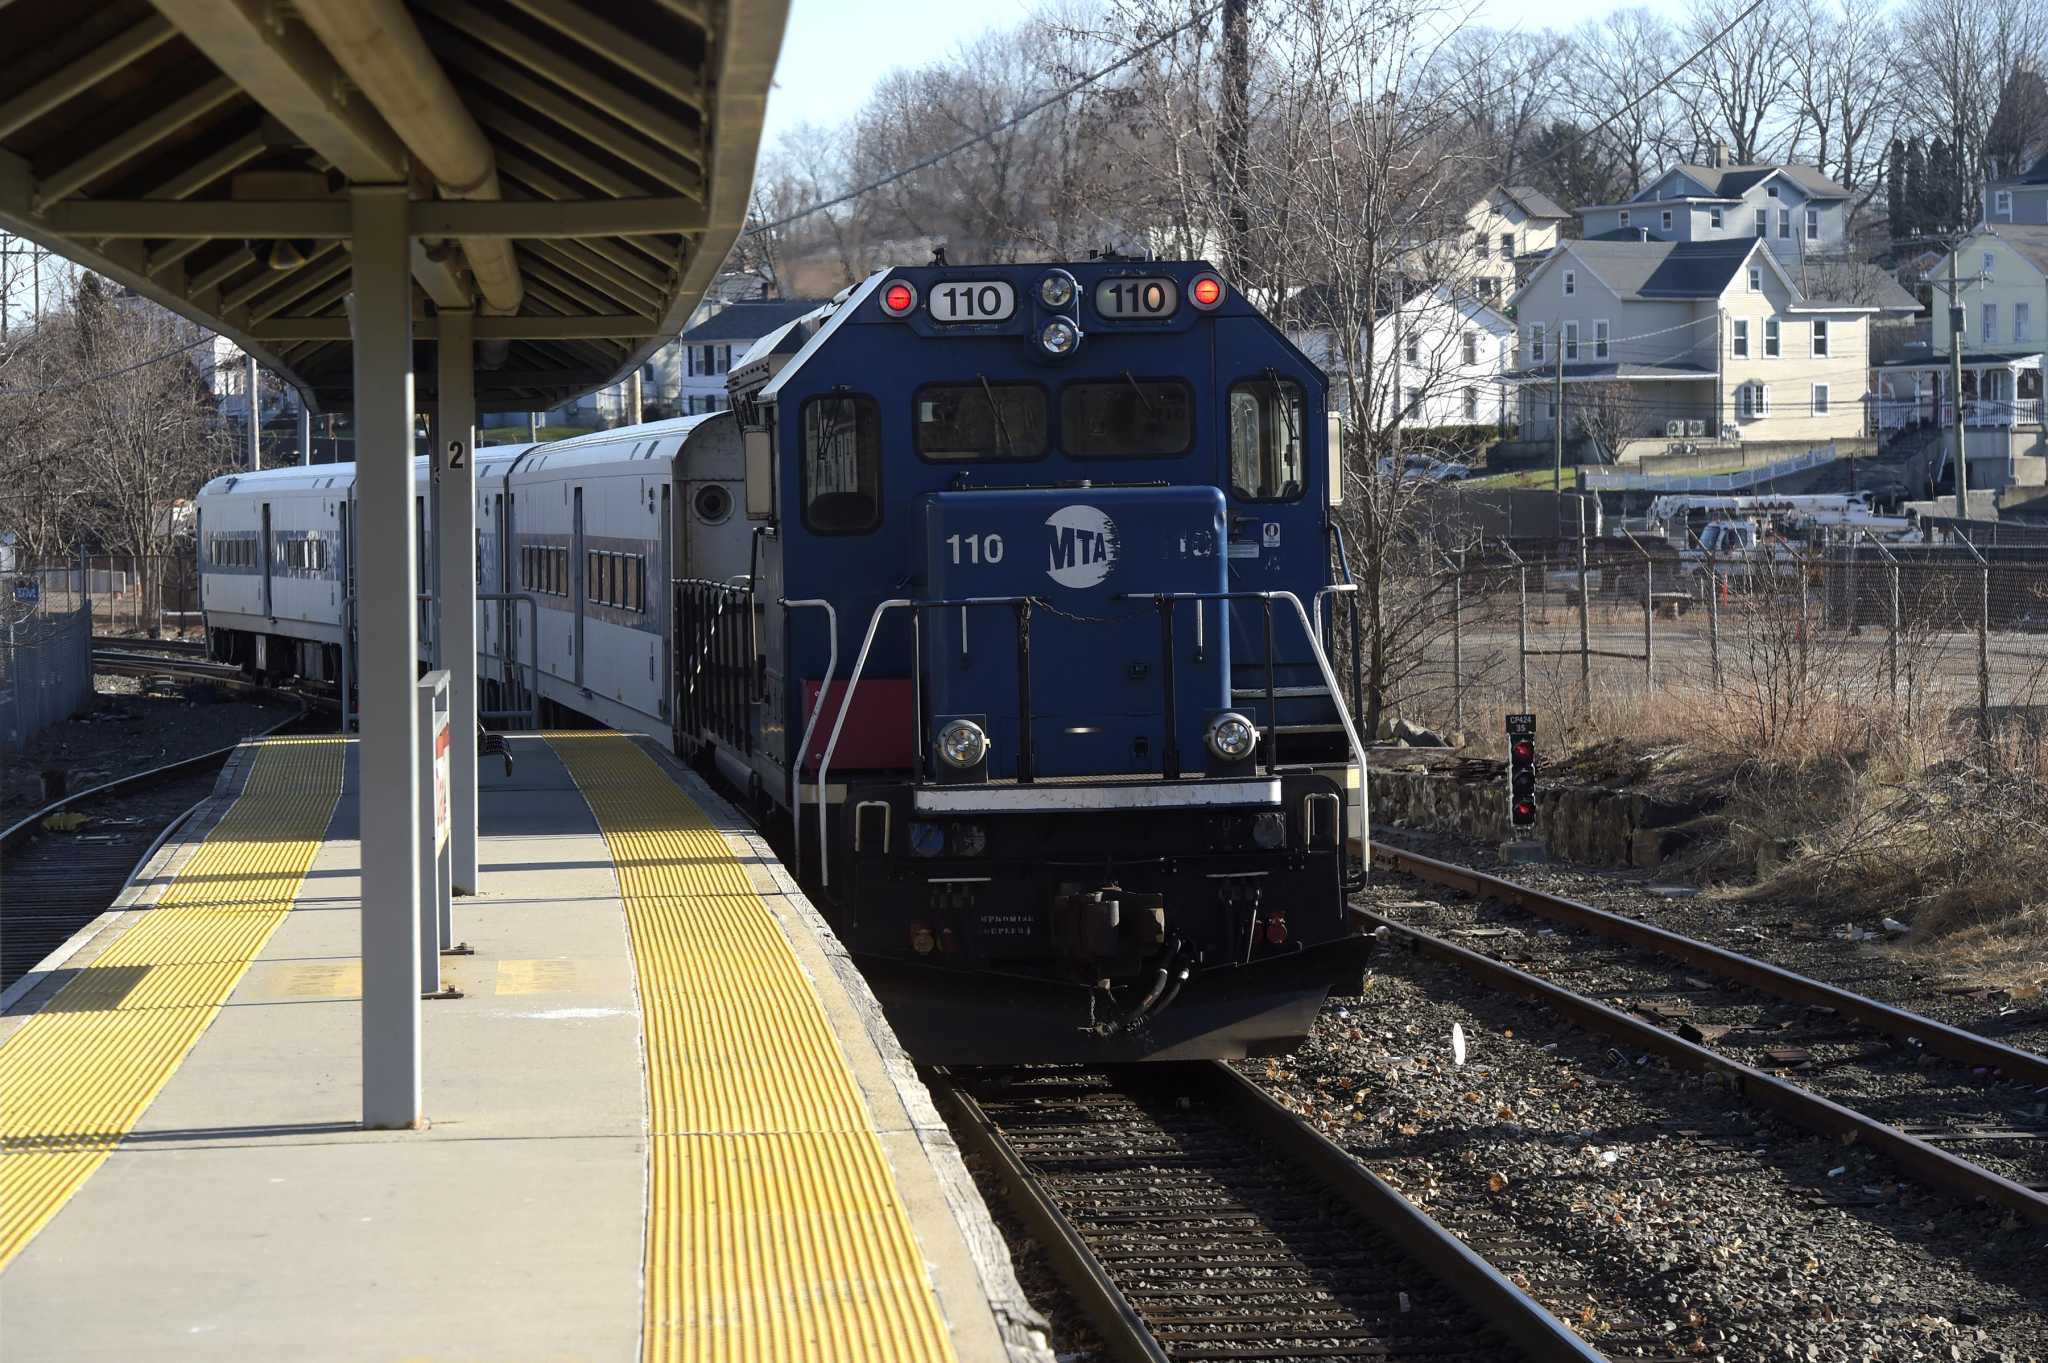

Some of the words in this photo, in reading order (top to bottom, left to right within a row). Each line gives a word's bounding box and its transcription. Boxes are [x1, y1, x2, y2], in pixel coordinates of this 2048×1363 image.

[943, 285, 1001, 316] 110
[1109, 283, 1165, 312] 110
[449, 441, 464, 469] 2
[946, 534, 1003, 564] 110
[1049, 524, 1108, 571] MTA
